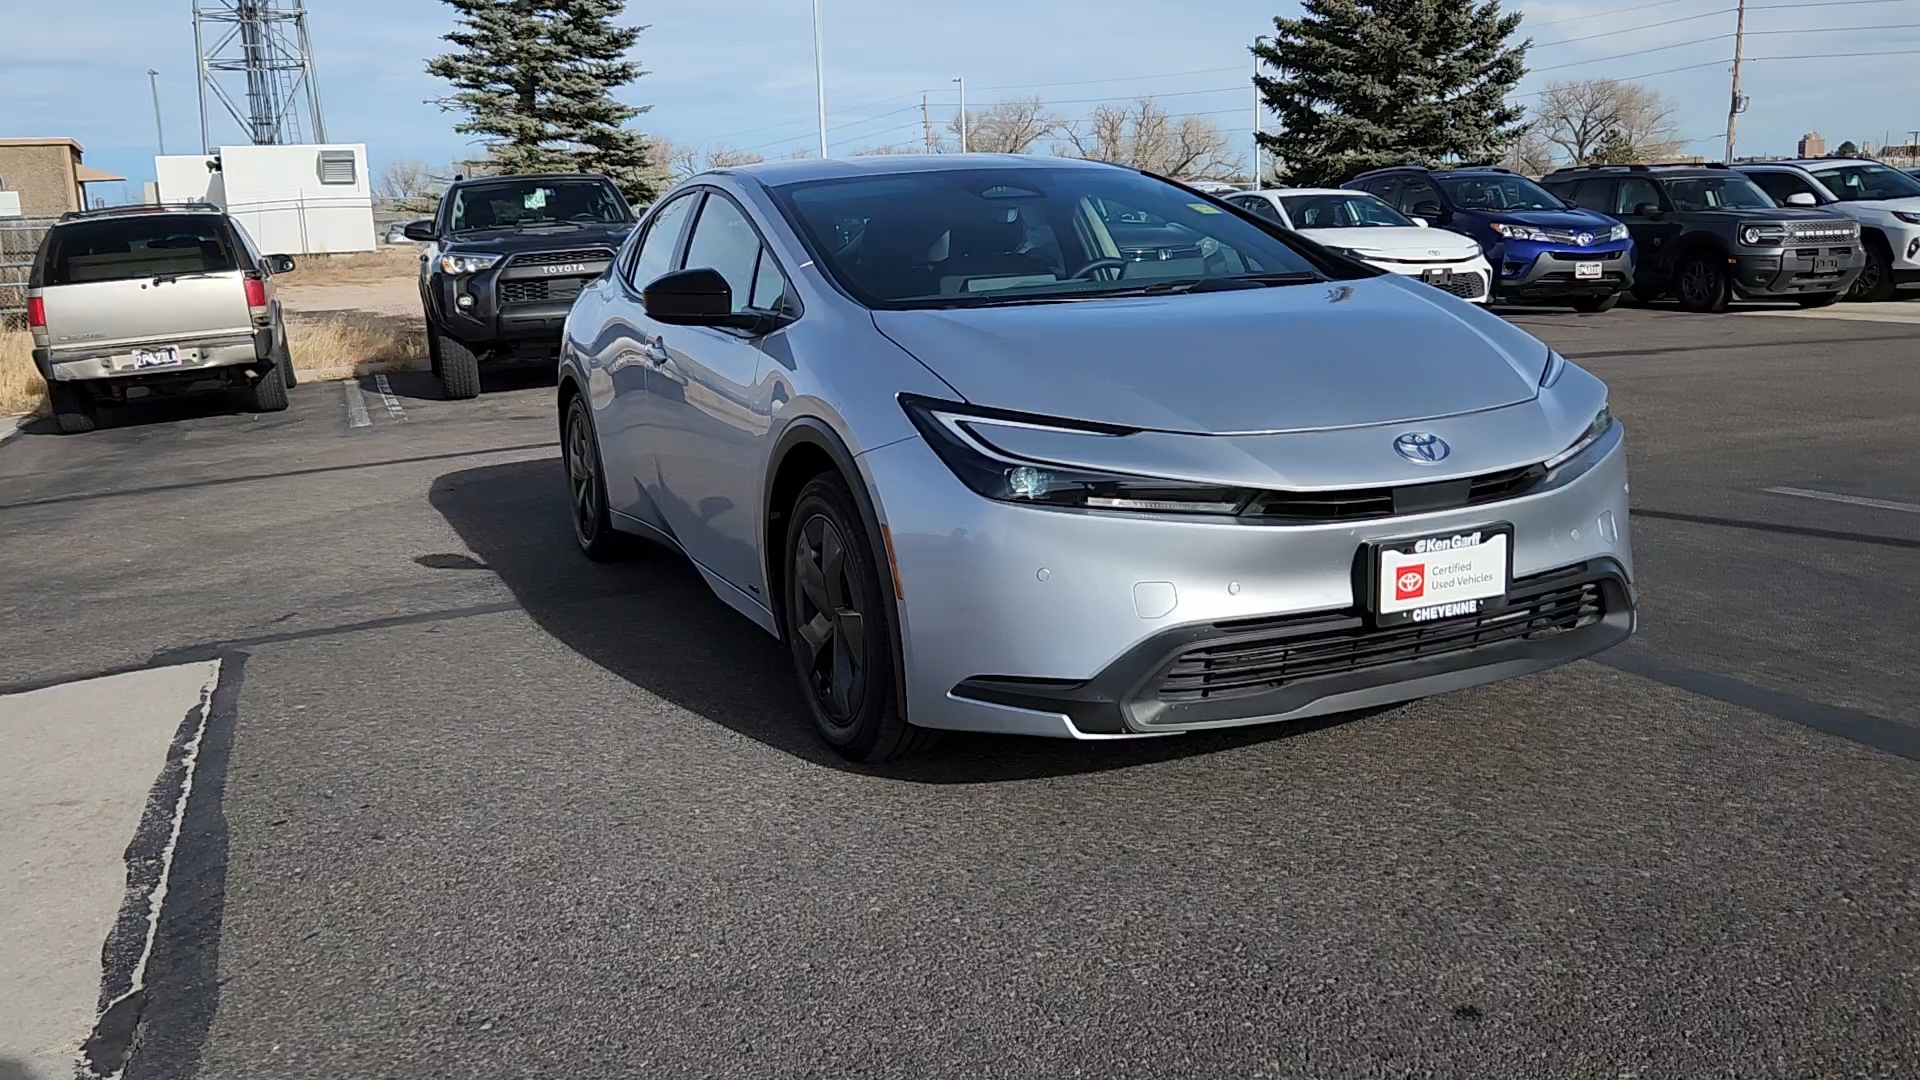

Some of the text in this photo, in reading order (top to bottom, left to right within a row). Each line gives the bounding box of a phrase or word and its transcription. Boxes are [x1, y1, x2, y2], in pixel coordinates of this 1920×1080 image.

[542, 264, 585, 274] TOYOTA
[1432, 561, 1472, 576] Certified
[1431, 572, 1493, 590] Used Vehicles
[1413, 600, 1477, 622] CHEYENNE
